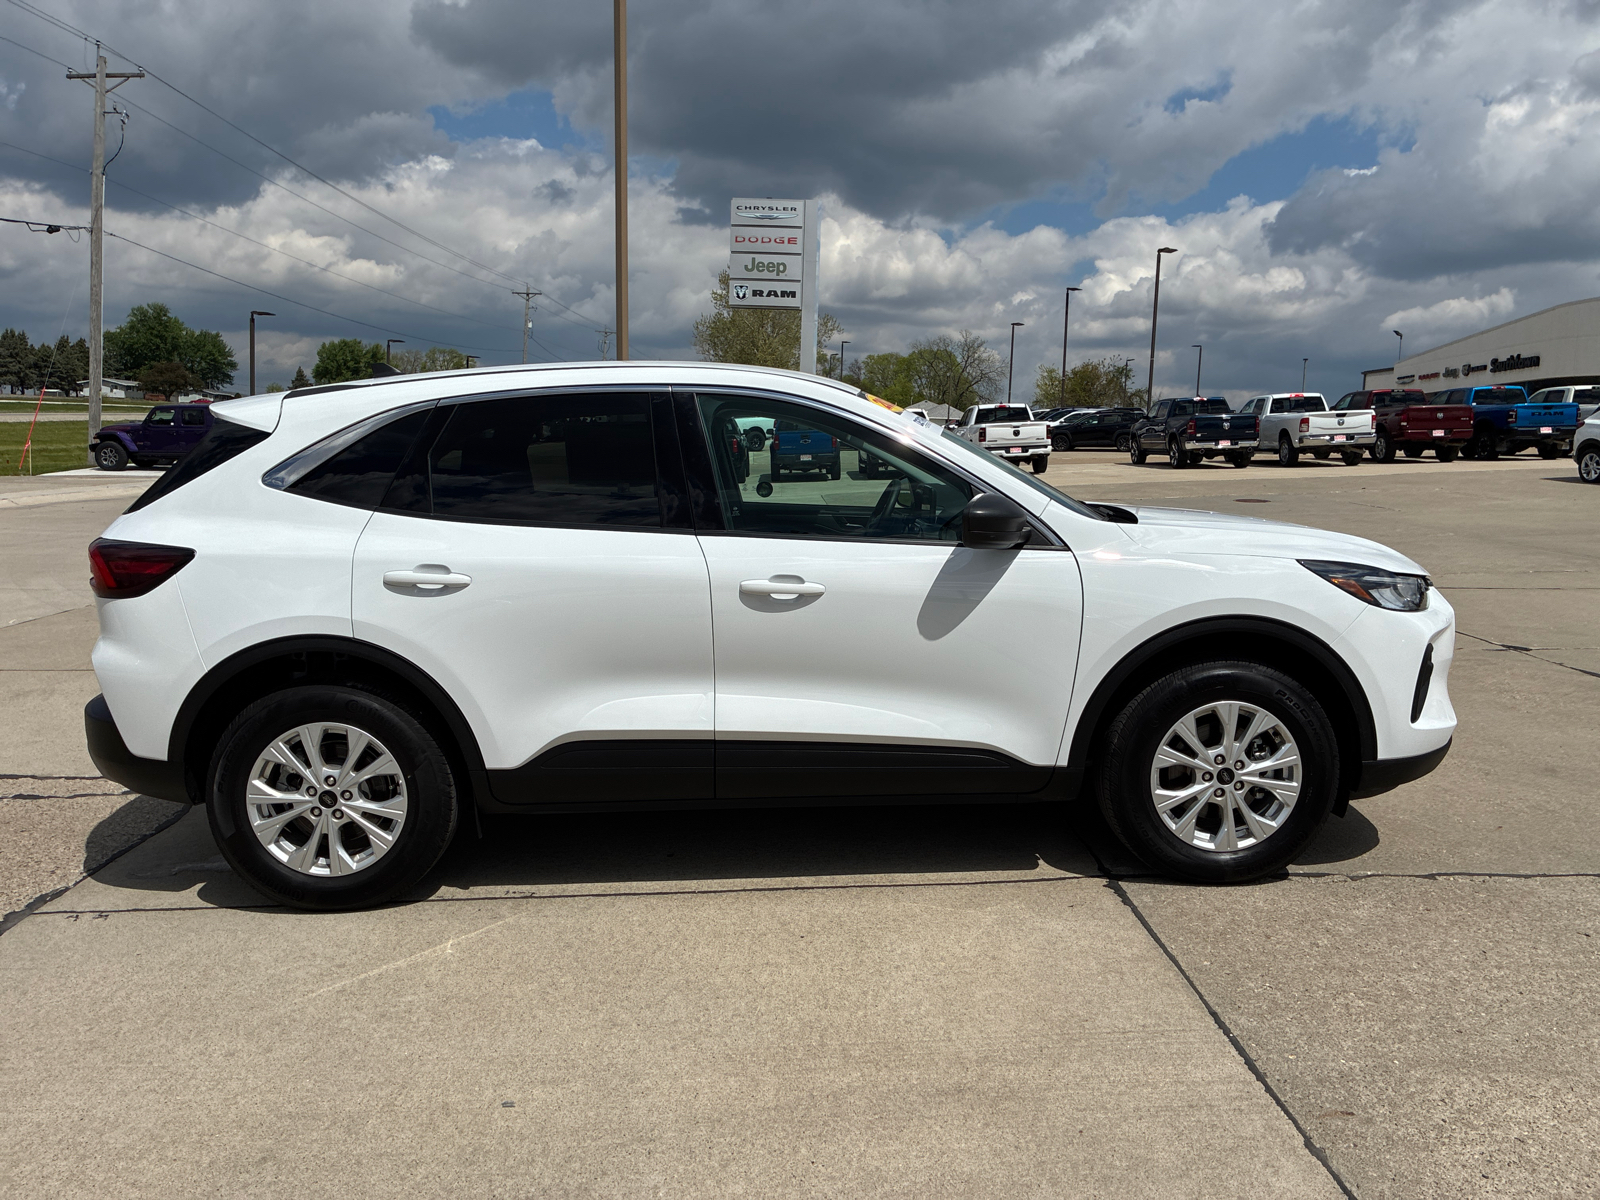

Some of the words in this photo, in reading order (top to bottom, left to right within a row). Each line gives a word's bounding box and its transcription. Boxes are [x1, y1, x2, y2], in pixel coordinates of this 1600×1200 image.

[735, 235, 798, 245] DODGE
[744, 257, 787, 277] Jeep
[752, 289, 797, 299] RAM
